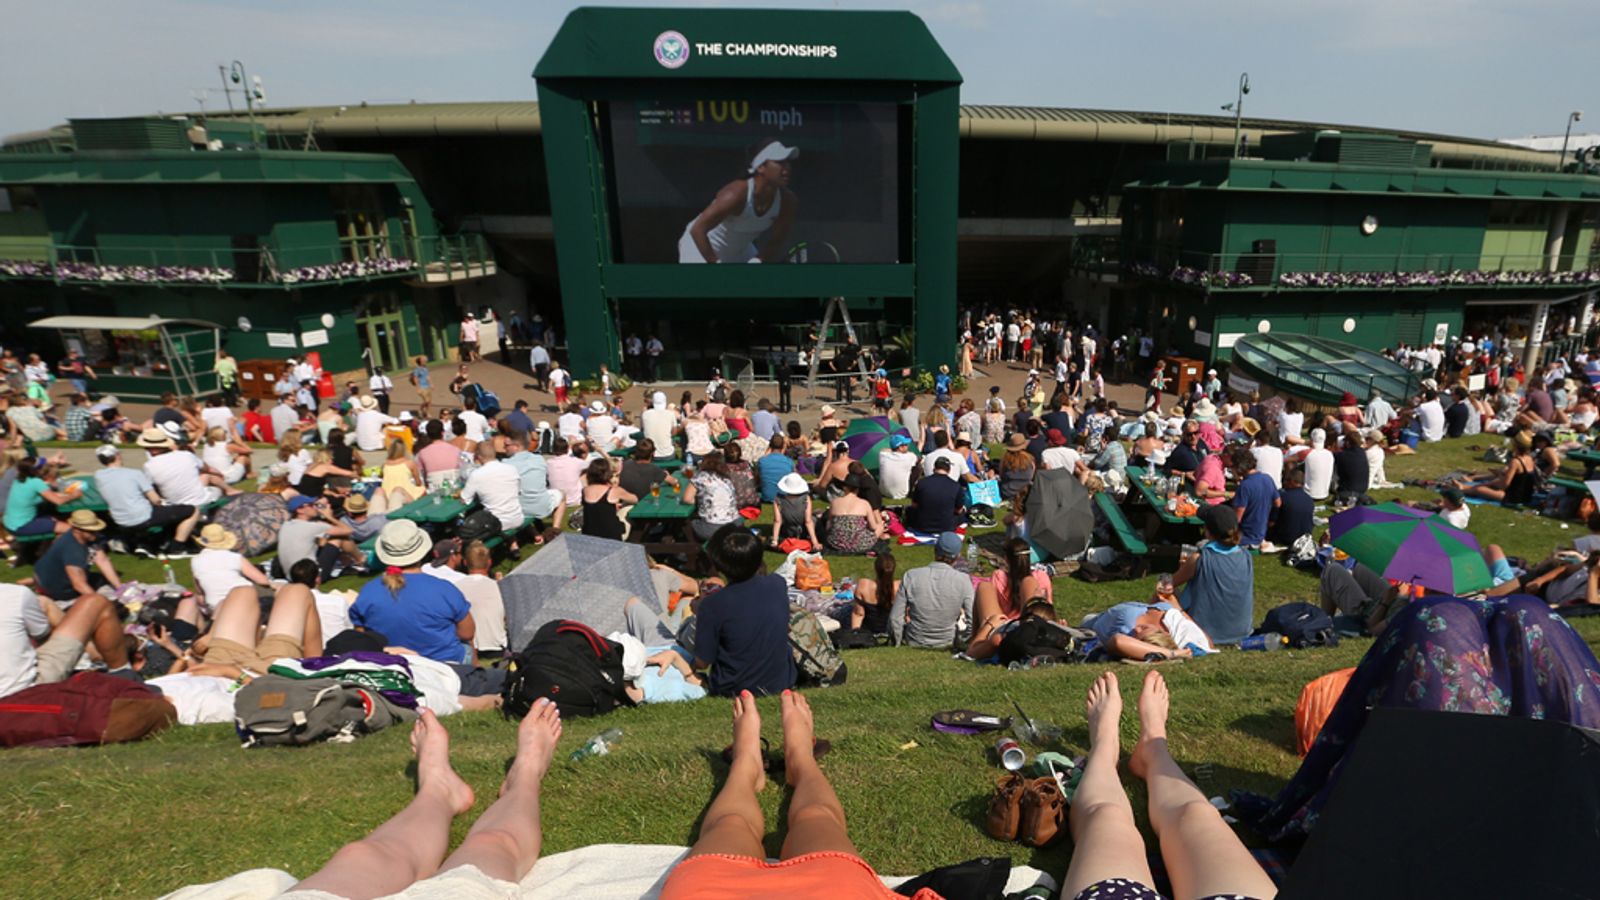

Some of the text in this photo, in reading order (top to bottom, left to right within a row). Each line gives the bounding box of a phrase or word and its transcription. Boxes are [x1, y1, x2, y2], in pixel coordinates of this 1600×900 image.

[696, 43, 838, 58] THE CHAMPIONSHIPS
[760, 107, 803, 131] mph
